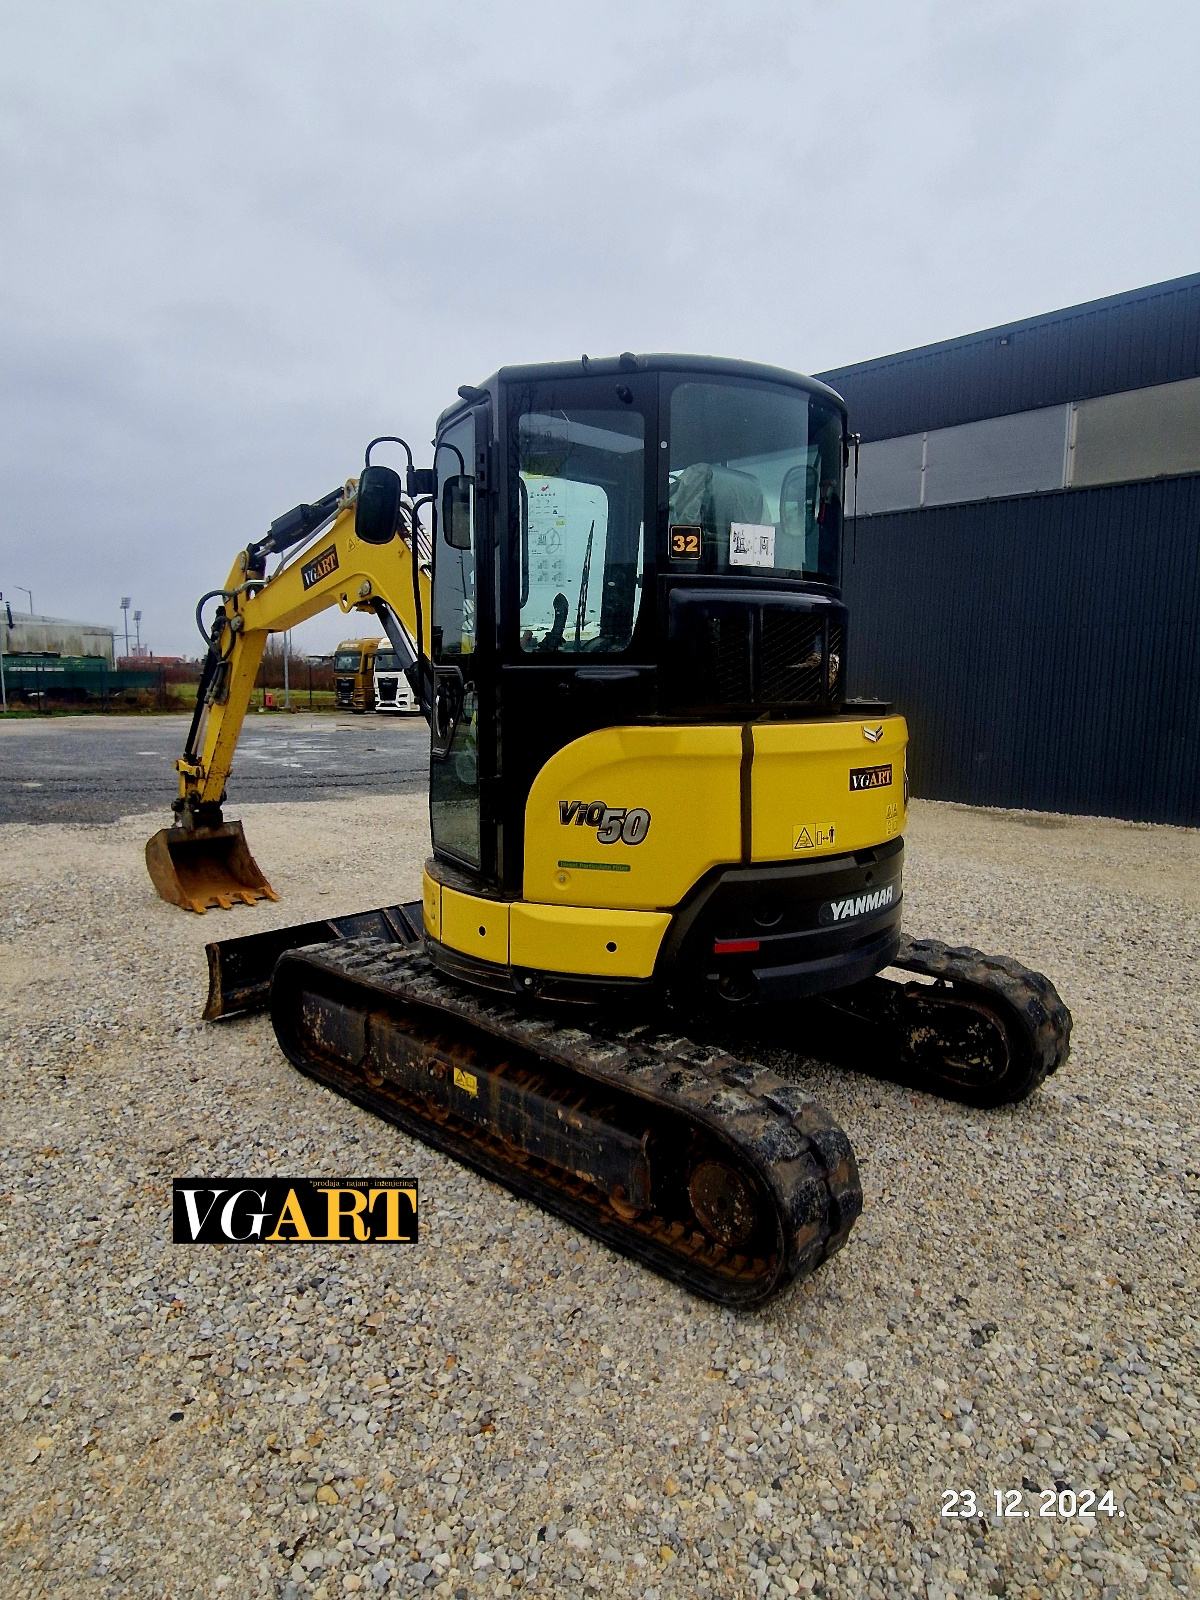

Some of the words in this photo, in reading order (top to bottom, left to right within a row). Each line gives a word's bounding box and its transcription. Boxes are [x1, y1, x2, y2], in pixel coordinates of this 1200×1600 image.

[672, 535, 699, 552] 32
[304, 553, 336, 586] VGART
[852, 769, 892, 789] VGART
[830, 885, 893, 921] YANMAR
